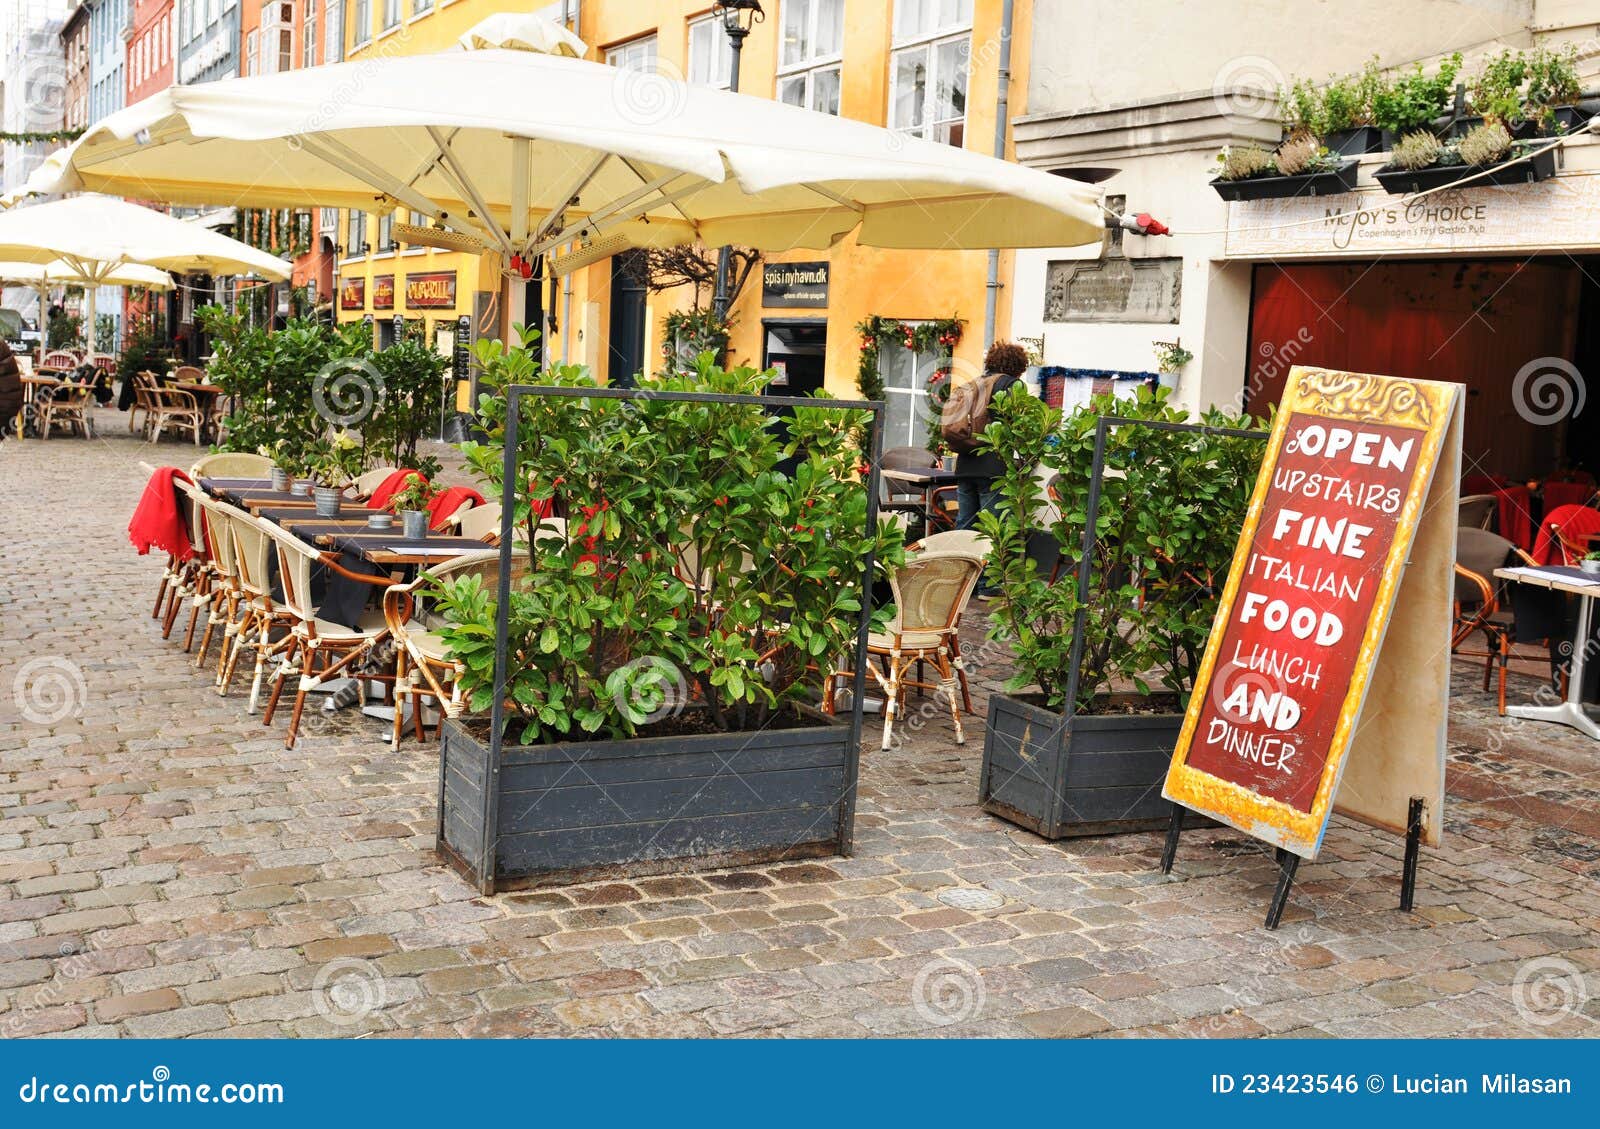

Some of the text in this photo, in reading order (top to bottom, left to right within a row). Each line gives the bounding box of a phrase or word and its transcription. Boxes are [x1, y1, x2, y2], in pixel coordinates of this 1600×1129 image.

[1401, 192, 1487, 224] CHOICE
[1419, 226, 1436, 236] First
[1438, 224, 1466, 235] Gastro
[1469, 224, 1486, 236] Pub
[1286, 425, 1415, 473] OPEN
[1274, 467, 1401, 513] UPSTAIRS
[1272, 508, 1374, 560] FINE
[1248, 553, 1364, 602] ITALIAN
[1239, 591, 1344, 647] FOOD
[1231, 639, 1323, 690] LUNCH
[1221, 683, 1301, 731] AND
[1206, 716, 1297, 775] DINNER
